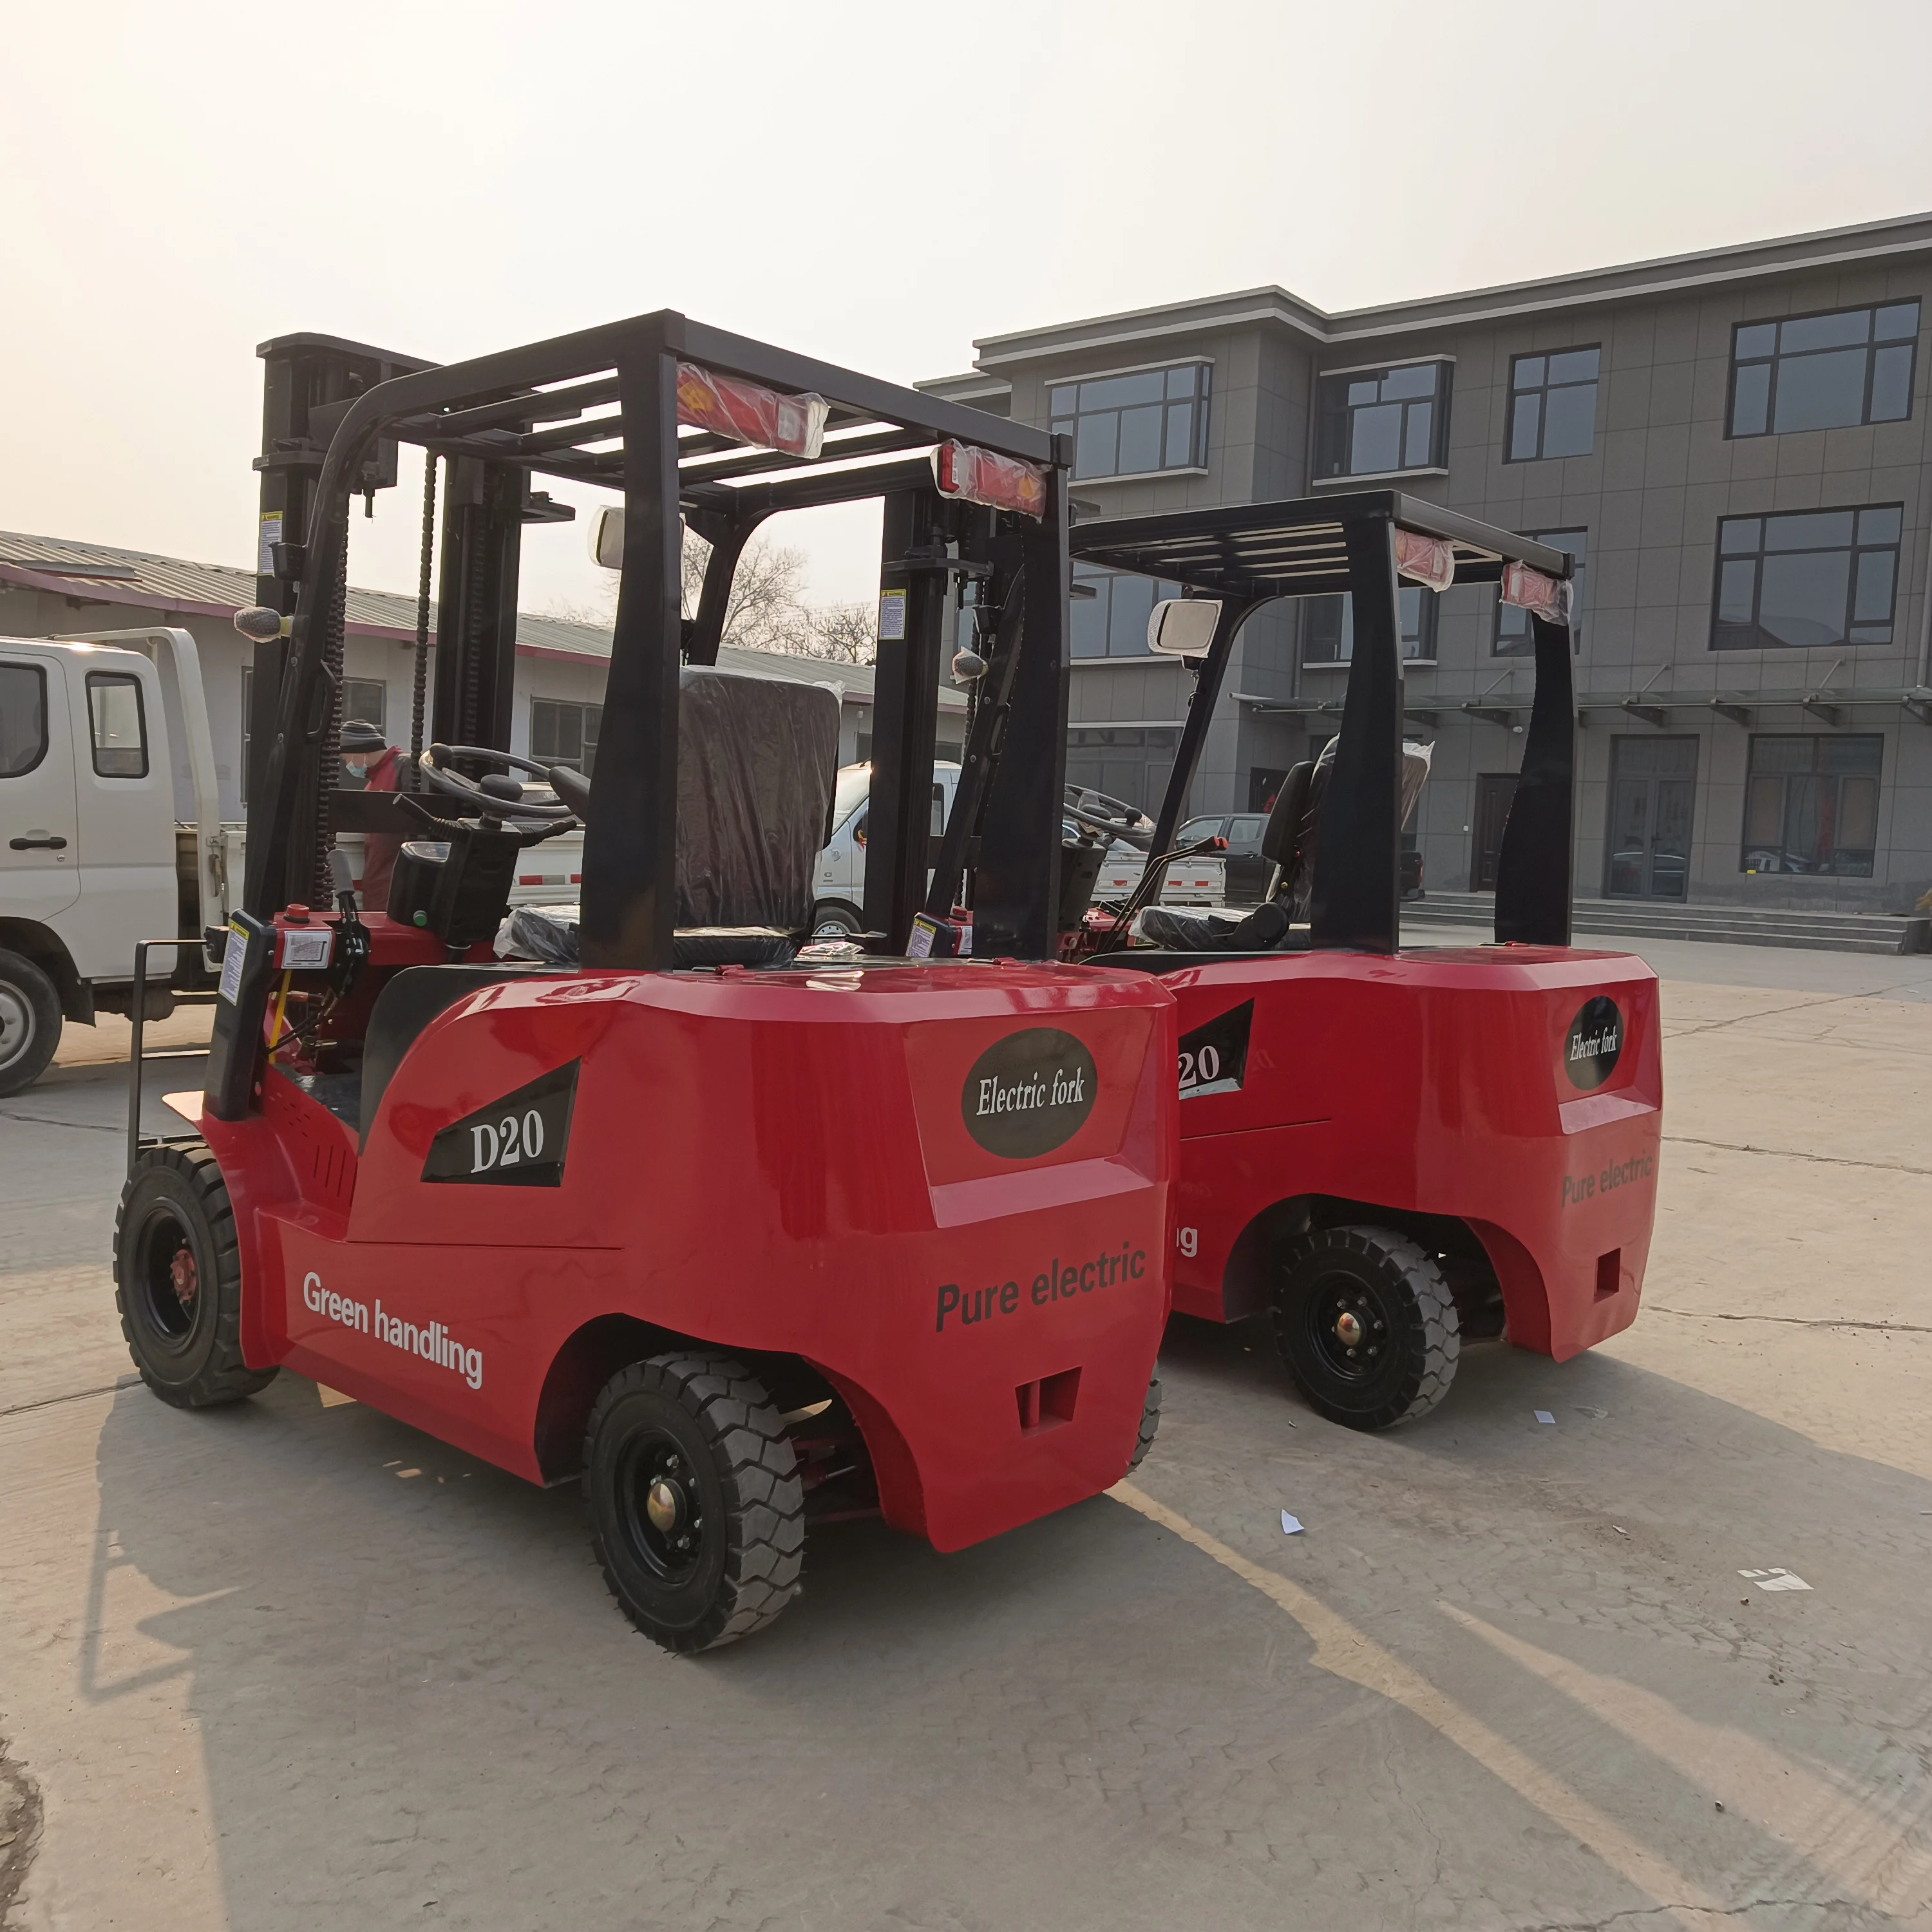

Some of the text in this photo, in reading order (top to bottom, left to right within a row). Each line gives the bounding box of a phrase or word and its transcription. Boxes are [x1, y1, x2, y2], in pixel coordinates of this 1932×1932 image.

[1570, 1025, 1618, 1061] Electric fork
[976, 1067, 1084, 1115] Electric fork
[470, 1110, 544, 1173] D20
[1562, 1148, 1653, 1209] Pure electric
[936, 1241, 1146, 1332] Pure electric
[304, 1272, 482, 1390] Green handling
